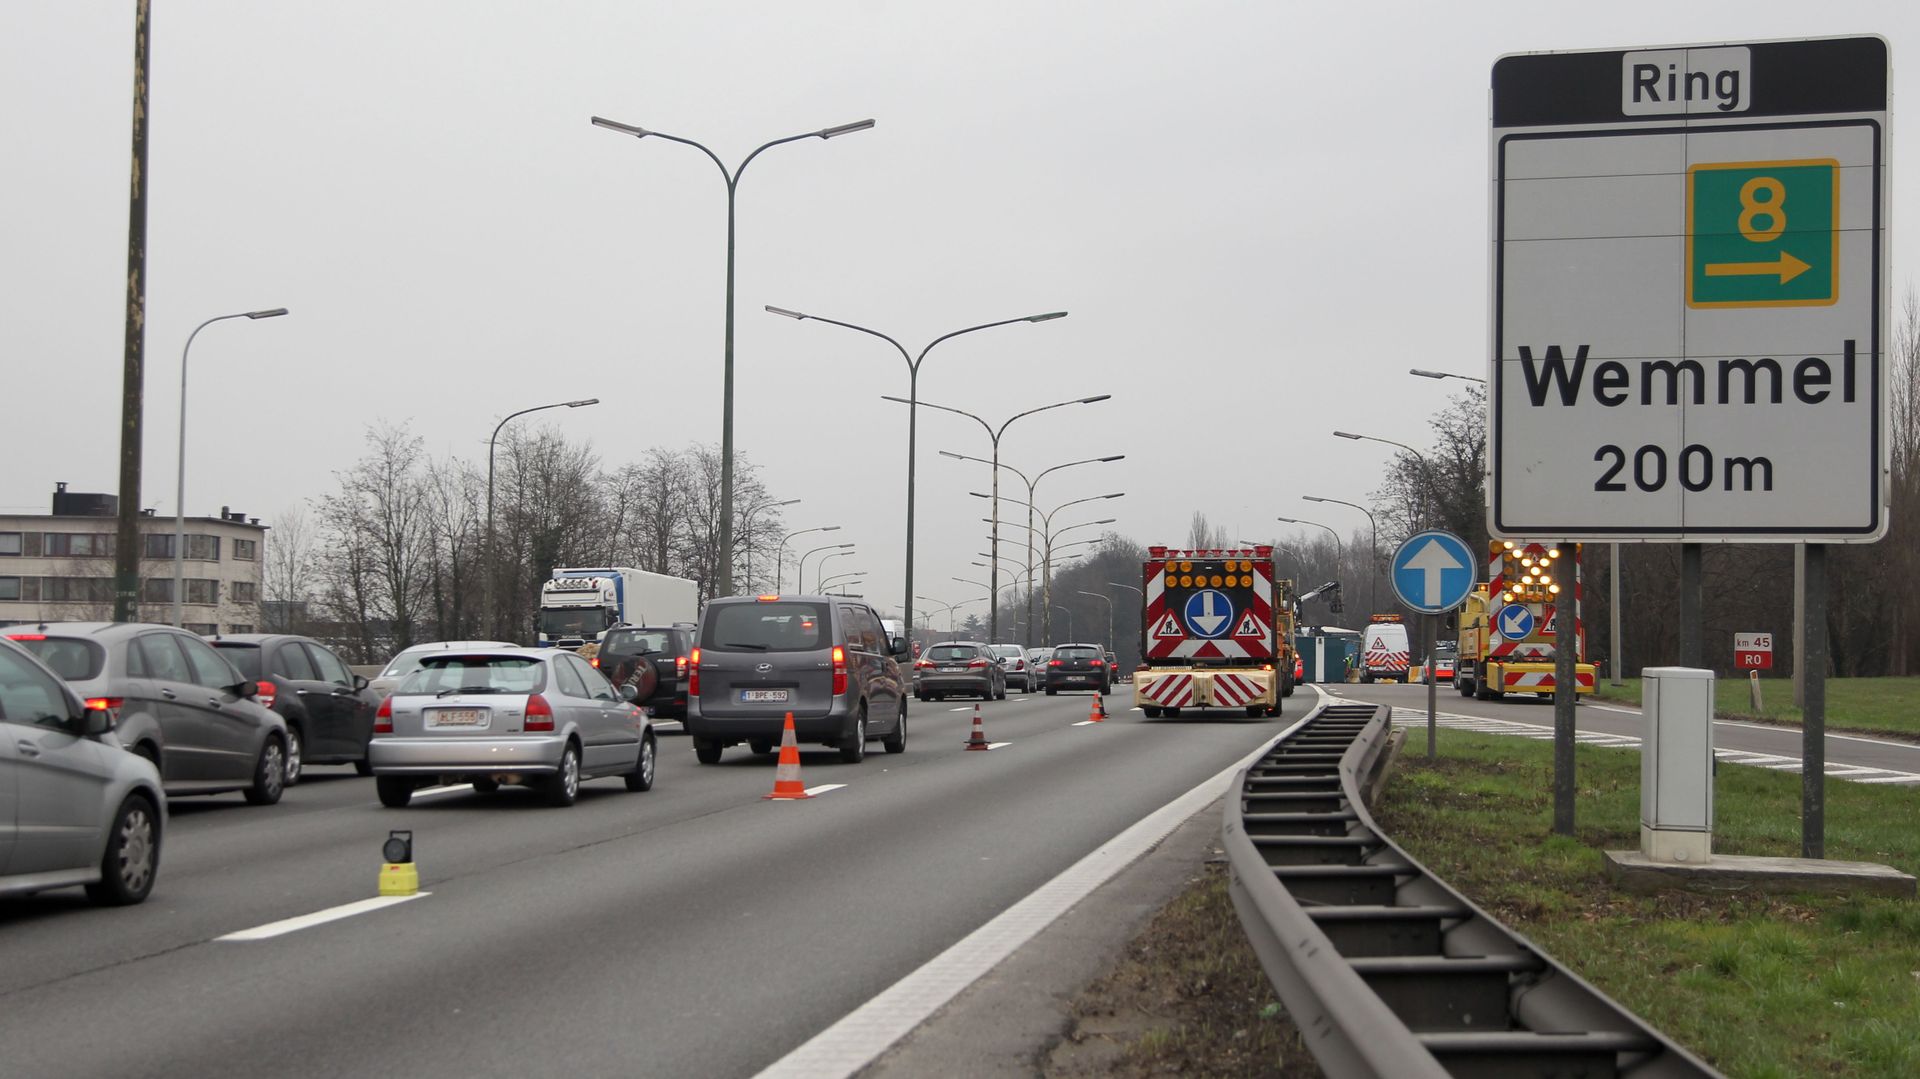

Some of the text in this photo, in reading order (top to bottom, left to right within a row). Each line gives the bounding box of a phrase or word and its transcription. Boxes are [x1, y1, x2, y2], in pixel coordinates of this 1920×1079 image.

[1633, 63, 1740, 111] Ring
[1738, 176, 1787, 242] 8
[1518, 339, 1856, 407] Wemmel
[1593, 443, 1774, 492] 200m
[1736, 637, 1770, 648] km 45
